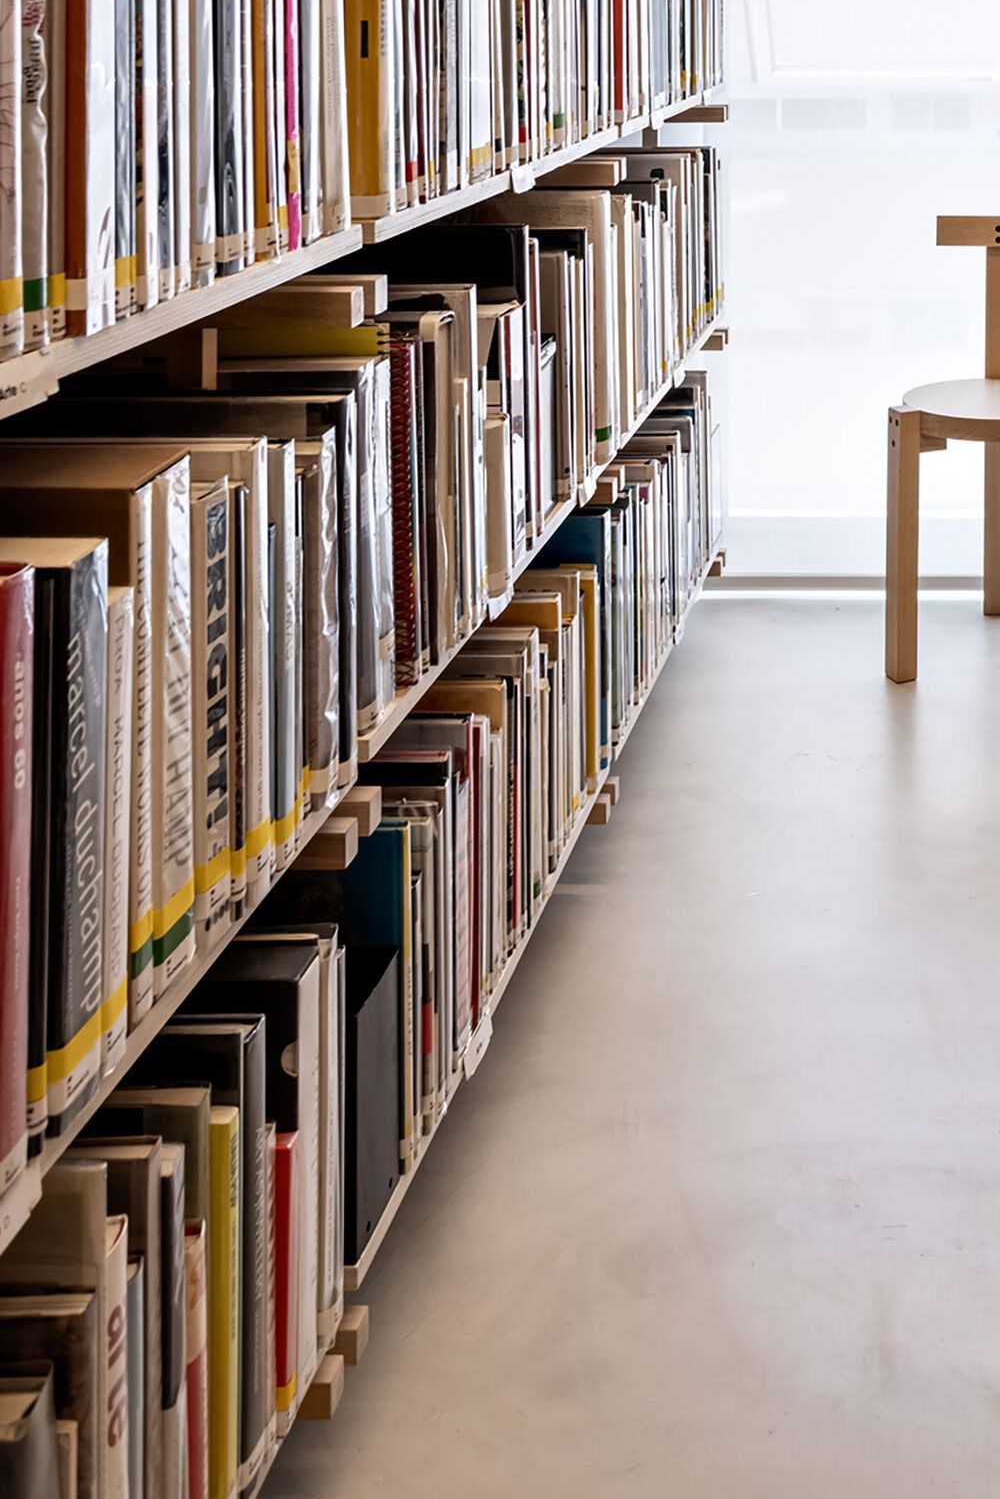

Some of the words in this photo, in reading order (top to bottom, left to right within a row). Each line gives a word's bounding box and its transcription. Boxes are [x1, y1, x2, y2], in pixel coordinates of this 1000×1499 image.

[13, 659, 26, 741] anos
[65, 630, 95, 788] marcel
[113, 614, 126, 694] PROA
[137, 604, 151, 757] COMPLETE
[207, 501, 229, 830] BRIGHT!
[13, 749, 26, 791] 60
[112, 715, 125, 832] MARCEL
[137, 771, 151, 868] WORKS
[74, 800, 104, 1013] duchamp
[110, 844, 123, 978] DUCHAMP
